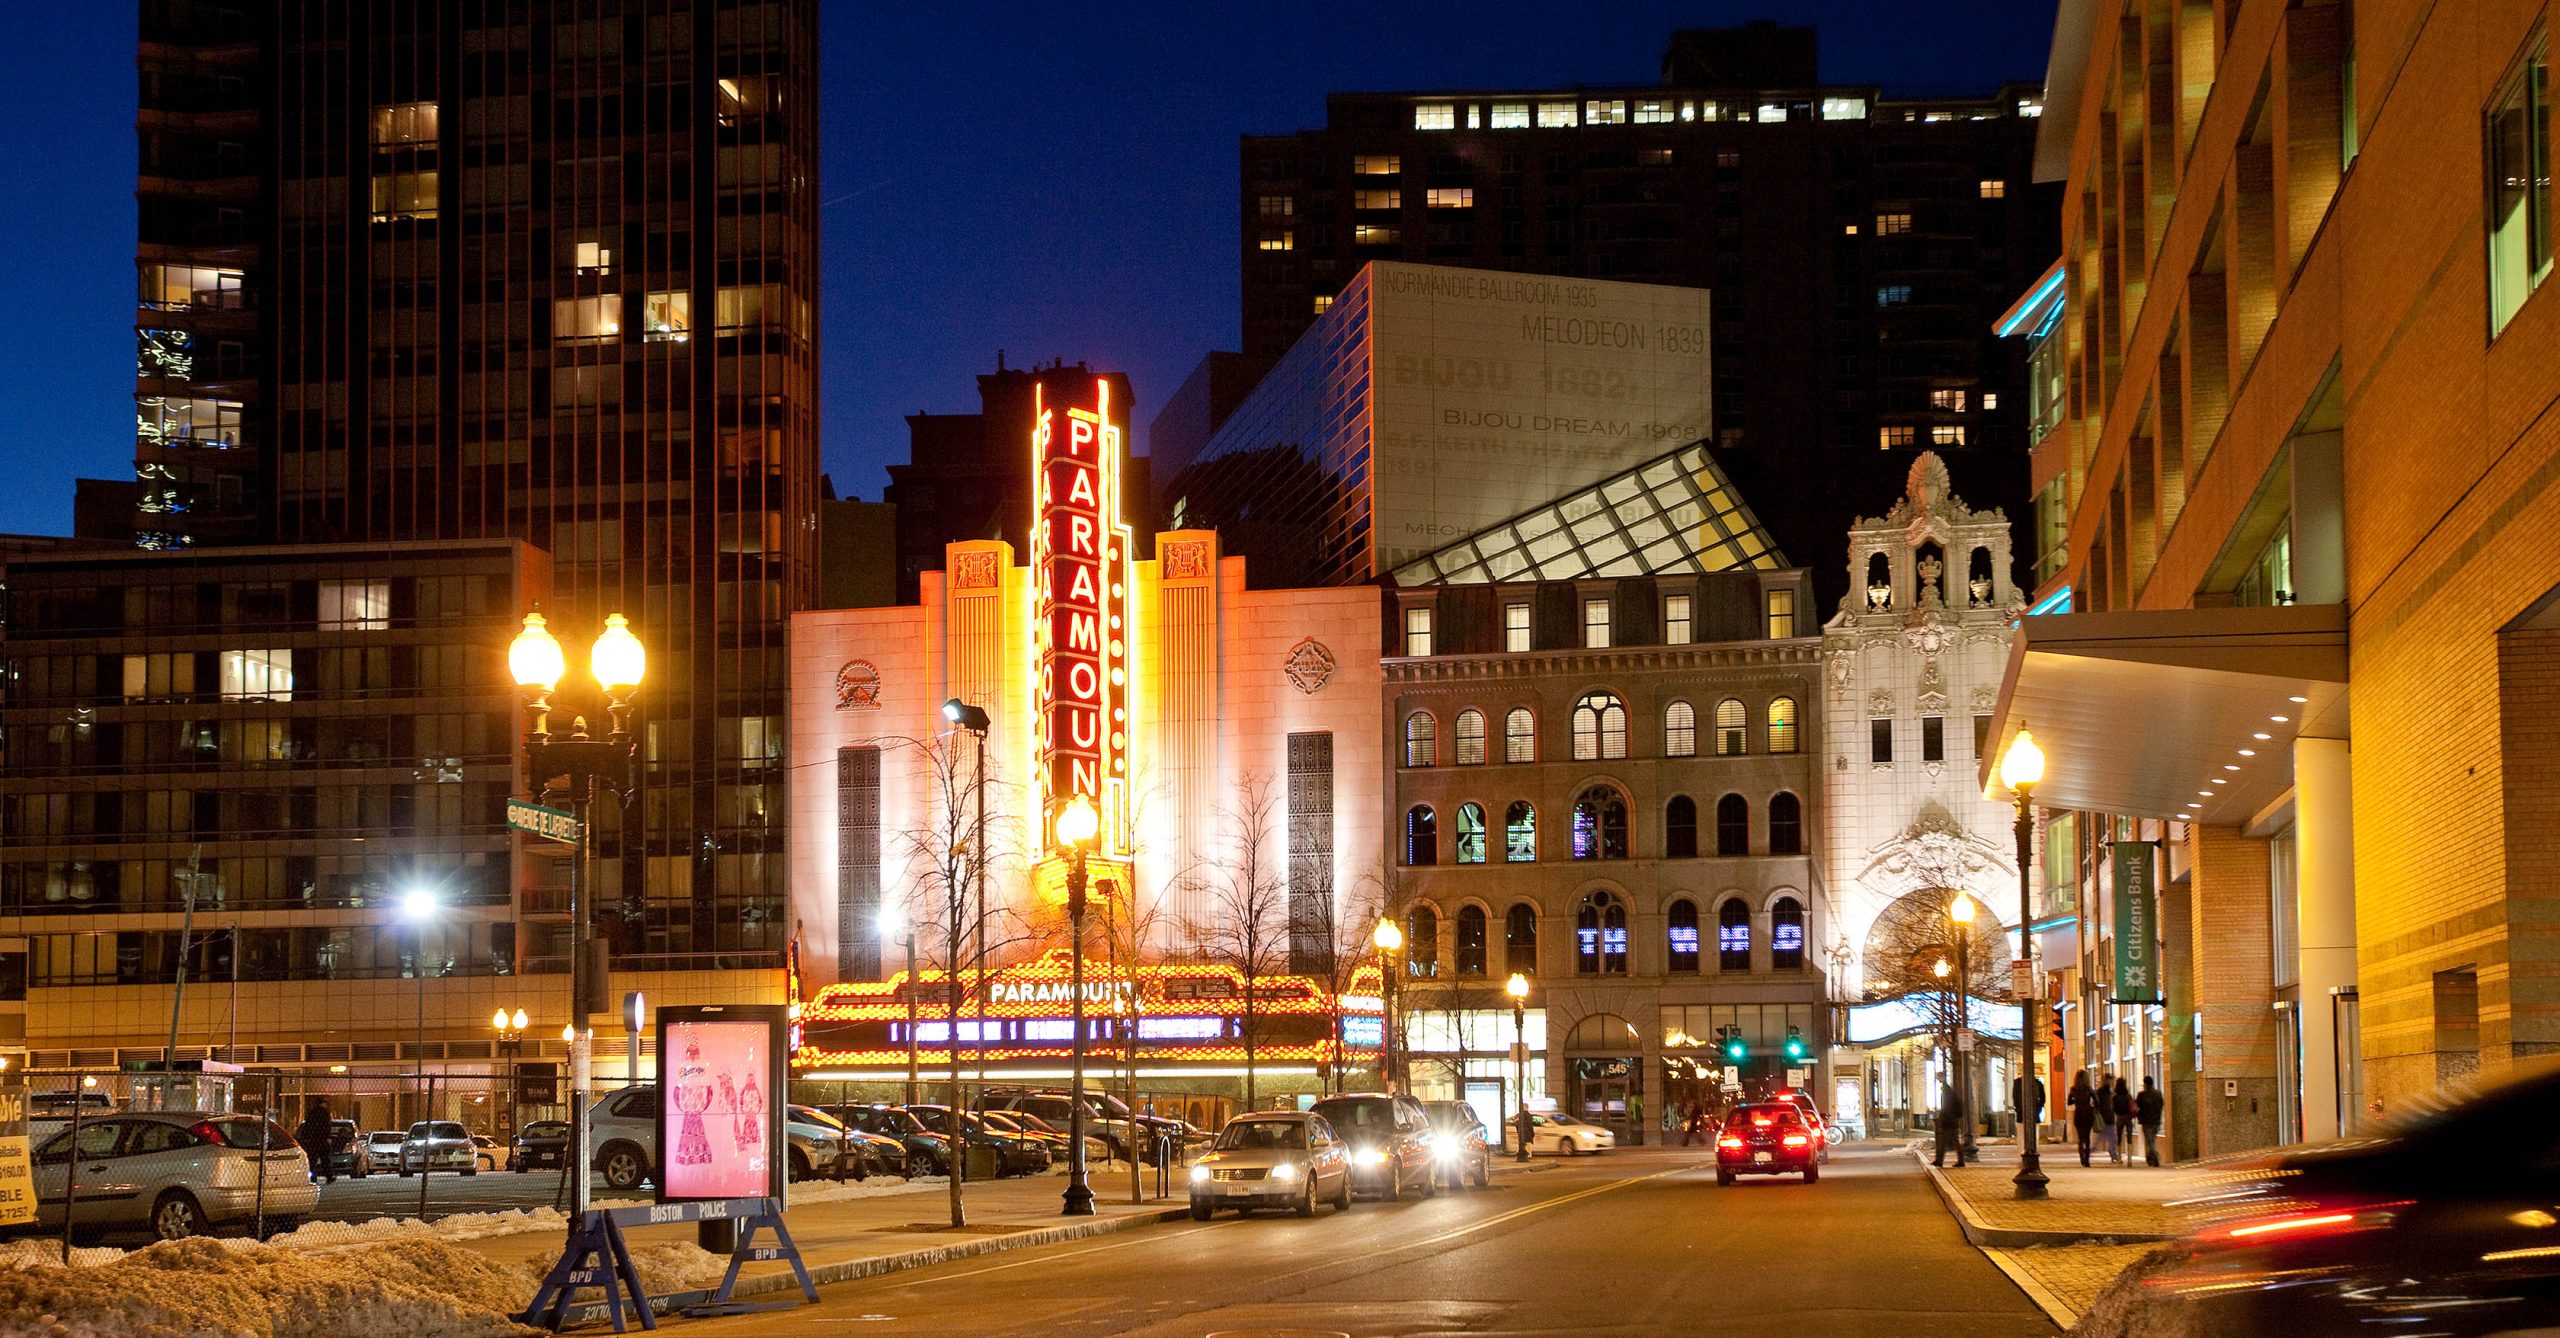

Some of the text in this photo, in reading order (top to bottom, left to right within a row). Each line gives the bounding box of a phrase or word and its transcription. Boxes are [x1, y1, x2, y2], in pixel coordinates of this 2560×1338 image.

[1385, 273, 1597, 308] NORMANDIE BALLROOM 1935
[1523, 316, 1704, 354] MELODEON 1839
[1395, 355, 1512, 391] BIJOU
[1444, 409, 1698, 441] BIJOU DREAM 1908
[1069, 419, 1097, 796] PARAMOUN
[2127, 856, 2143, 961] Citizens Bank
[1608, 1064, 1627, 1074] 545
[650, 1201, 728, 1223] BOSTON POLICE
[755, 1248, 778, 1260] BPD
[569, 1271, 594, 1284] BPD
[582, 1304, 611, 1321] OLICE
